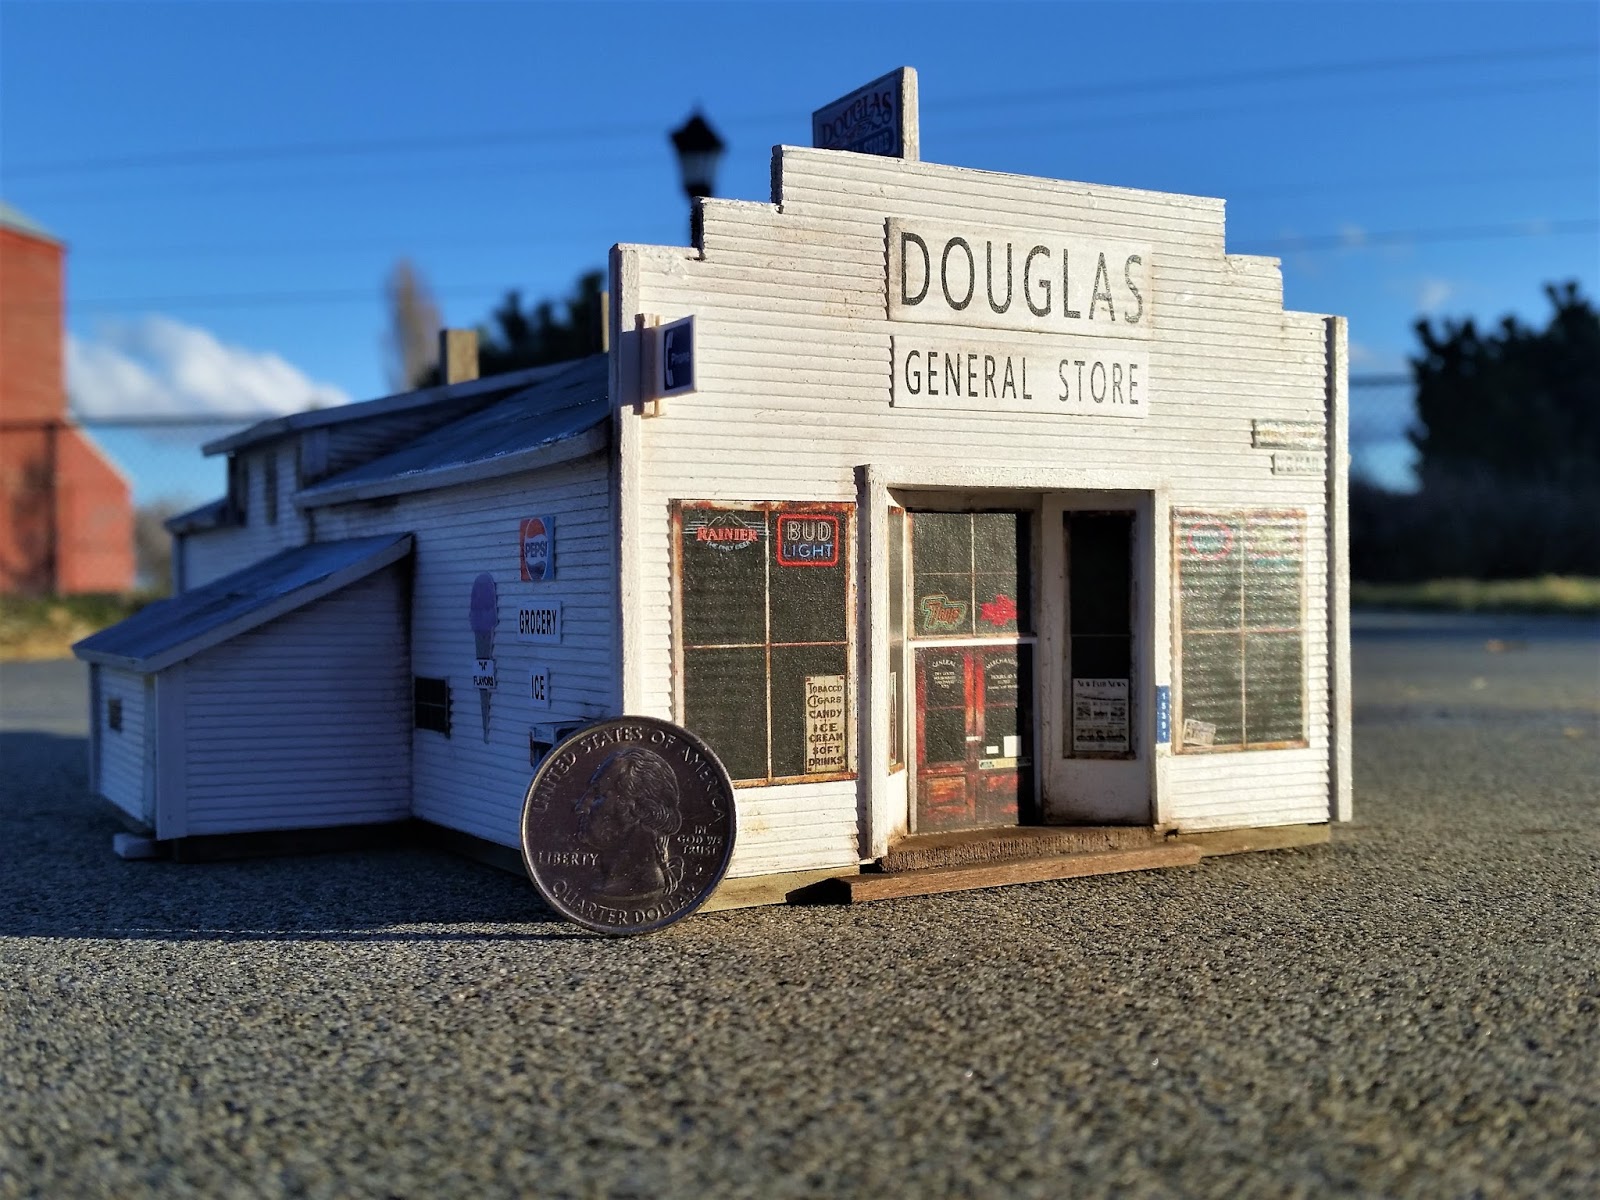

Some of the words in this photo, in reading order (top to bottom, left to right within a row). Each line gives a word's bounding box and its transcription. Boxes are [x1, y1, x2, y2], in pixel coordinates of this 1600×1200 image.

[821, 91, 893, 145] DOUGLAS
[900, 231, 1143, 324] DOUGLAS
[904, 349, 1033, 401] GENERAL
[1058, 358, 1139, 405] STORE
[696, 526, 759, 541] RAINIER
[786, 520, 832, 541] BUD
[525, 540, 548, 558] PEPSI
[782, 543, 834, 558] LIGHT
[519, 608, 557, 635] GROCERY
[473, 675, 494, 687] FLAVORS
[531, 674, 545, 700] ICE
[807, 682, 843, 694] TOBACCO
[807, 695, 842, 708] CIGARS
[809, 709, 843, 719] CANDY
[813, 723, 838, 733] ICE
[808, 733, 843, 743] CREAM
[812, 745, 841, 755] SOFT
[808, 756, 843, 767] DRINKS
[532, 752, 577, 813] UNITED
[580, 726, 643, 754] STATES
[651, 729, 677, 750] OF
[681, 746, 726, 825] AMERICA
[694, 824, 707, 834] IN
[677, 834, 704, 844] GOD
[538, 851, 599, 867] LIBERTY
[552, 879, 629, 926] QUARTER
[633, 884, 702, 924] DOLLAR
